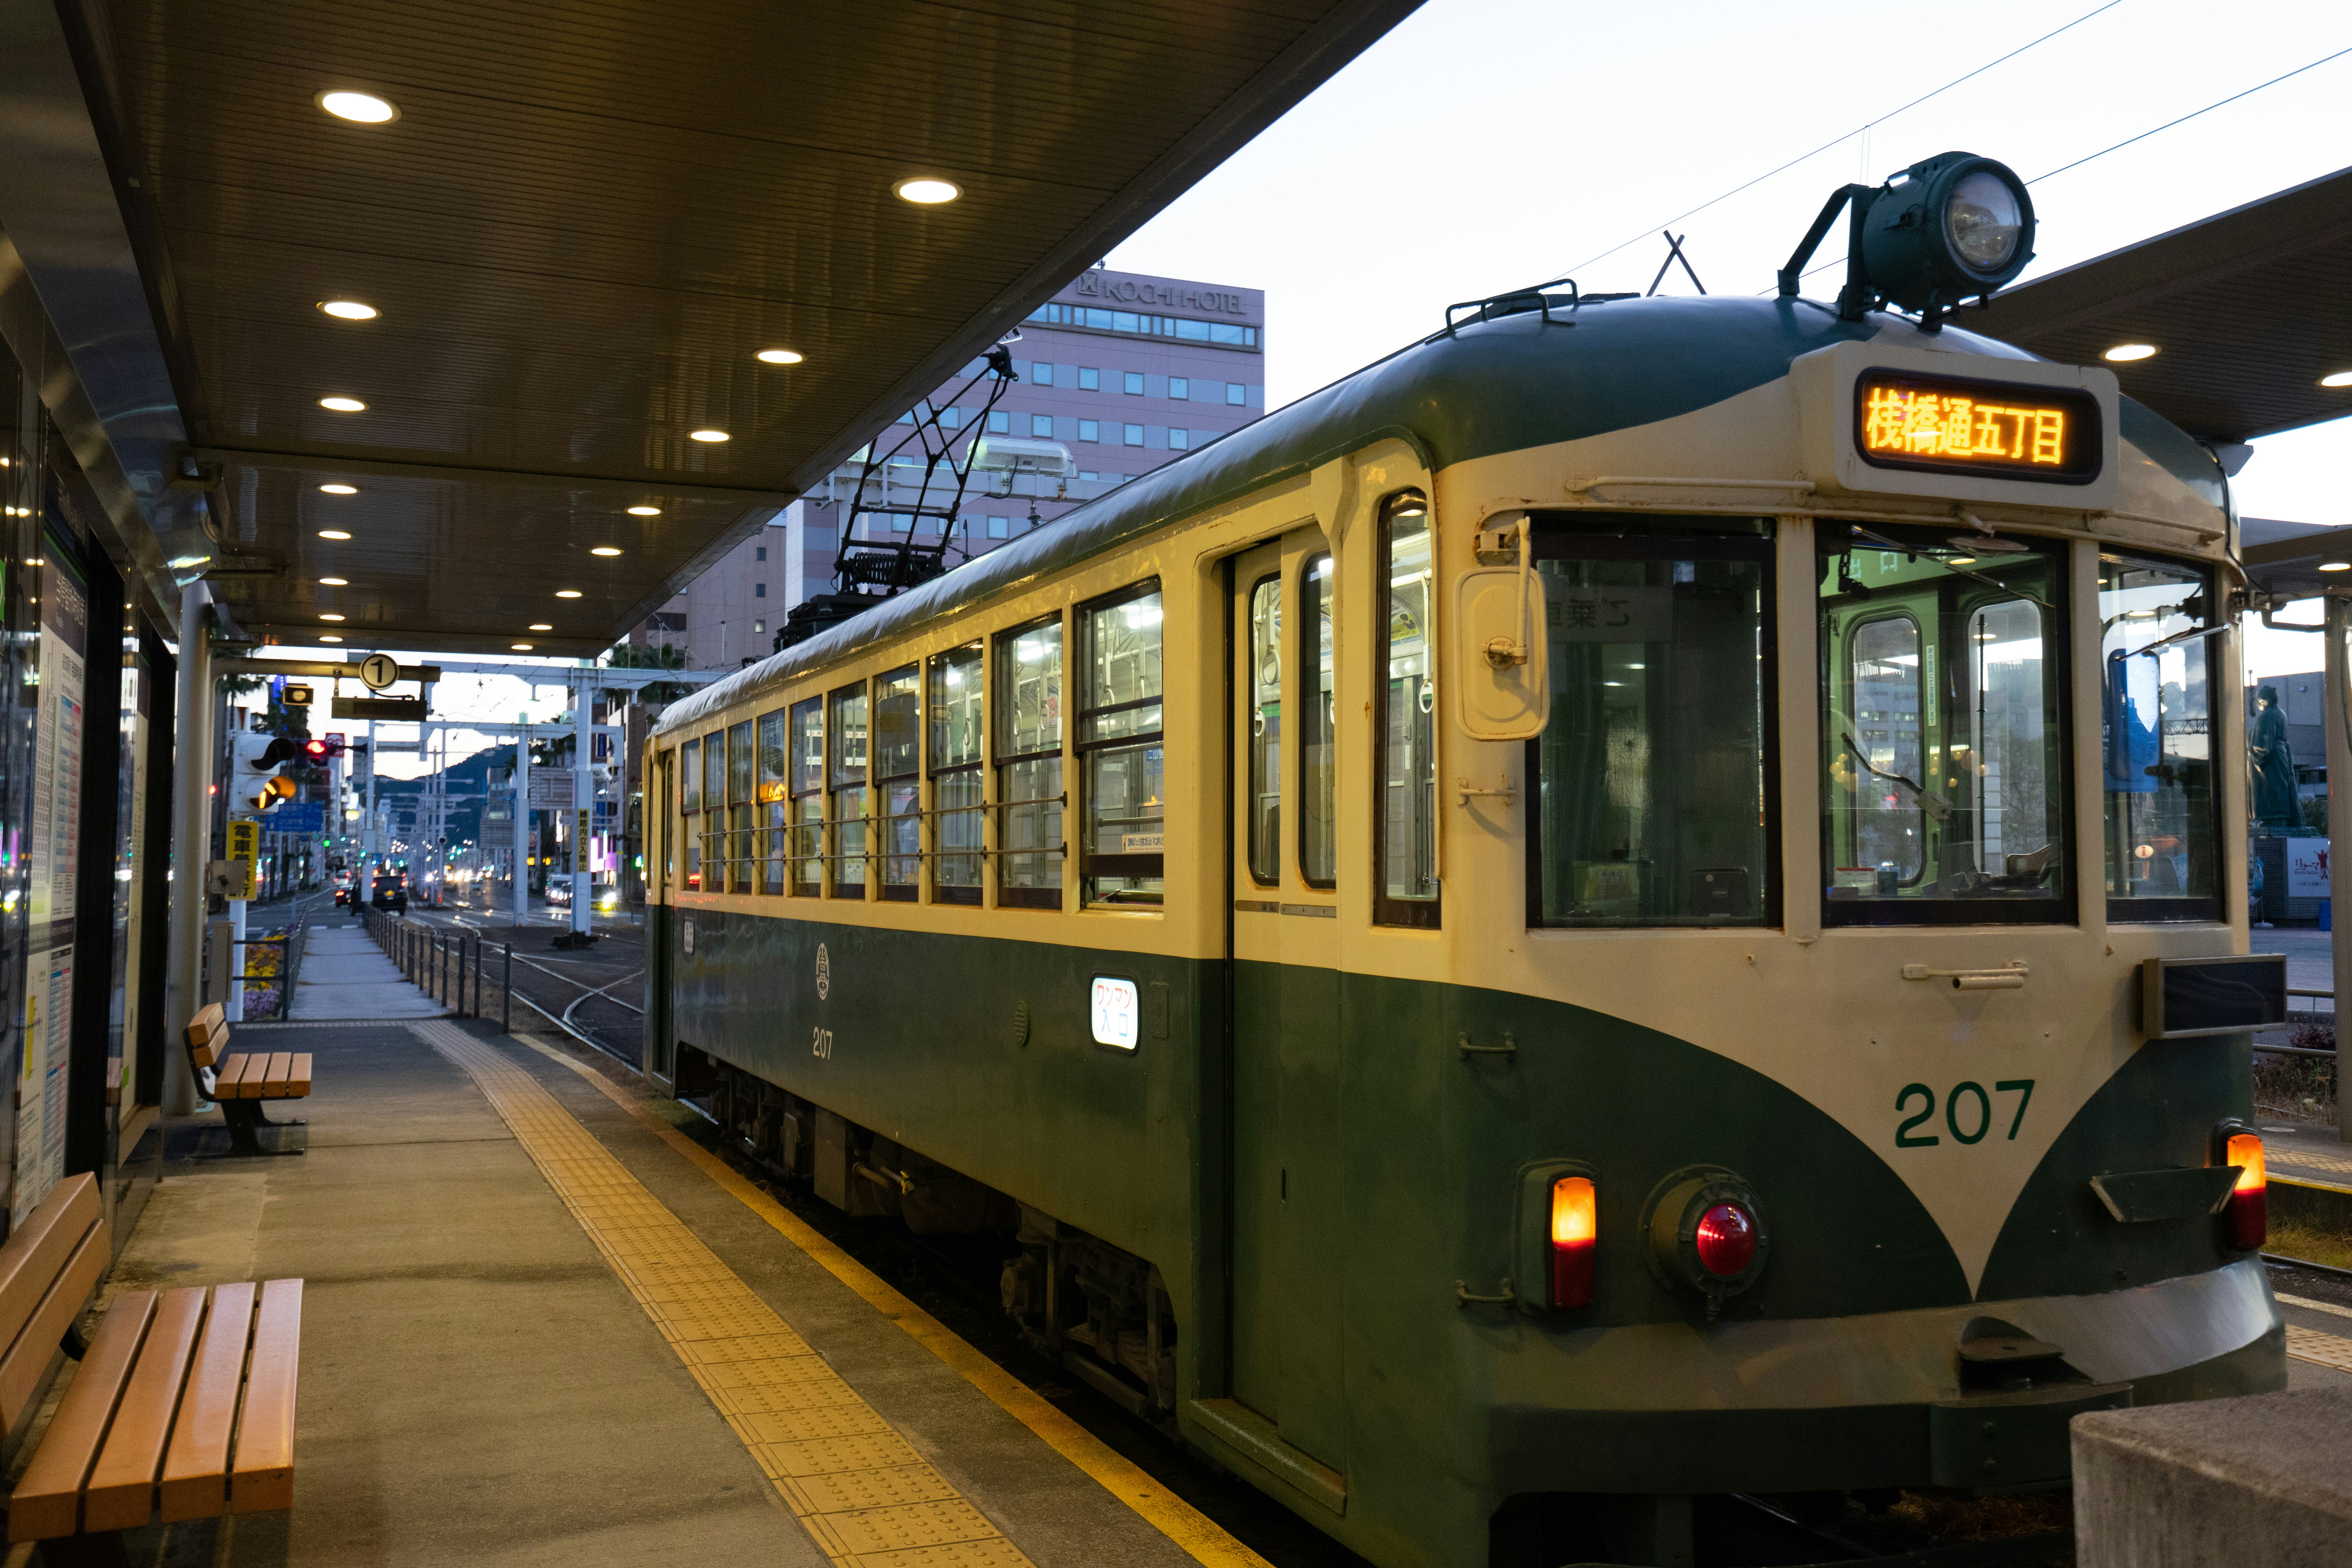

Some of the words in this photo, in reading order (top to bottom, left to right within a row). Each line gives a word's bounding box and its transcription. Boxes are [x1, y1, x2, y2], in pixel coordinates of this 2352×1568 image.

[1105, 279, 1176, 305] KOCHI
[1182, 289, 1246, 314] HOTEL
[1867, 387, 2063, 465] 桟橋通五丁目
[370, 659, 383, 683] 1
[1097, 984, 1132, 1009] ワンマン
[1101, 1009, 1128, 1037] 入口
[813, 1026, 833, 1060] 207
[1895, 1079, 2035, 1149] 207
